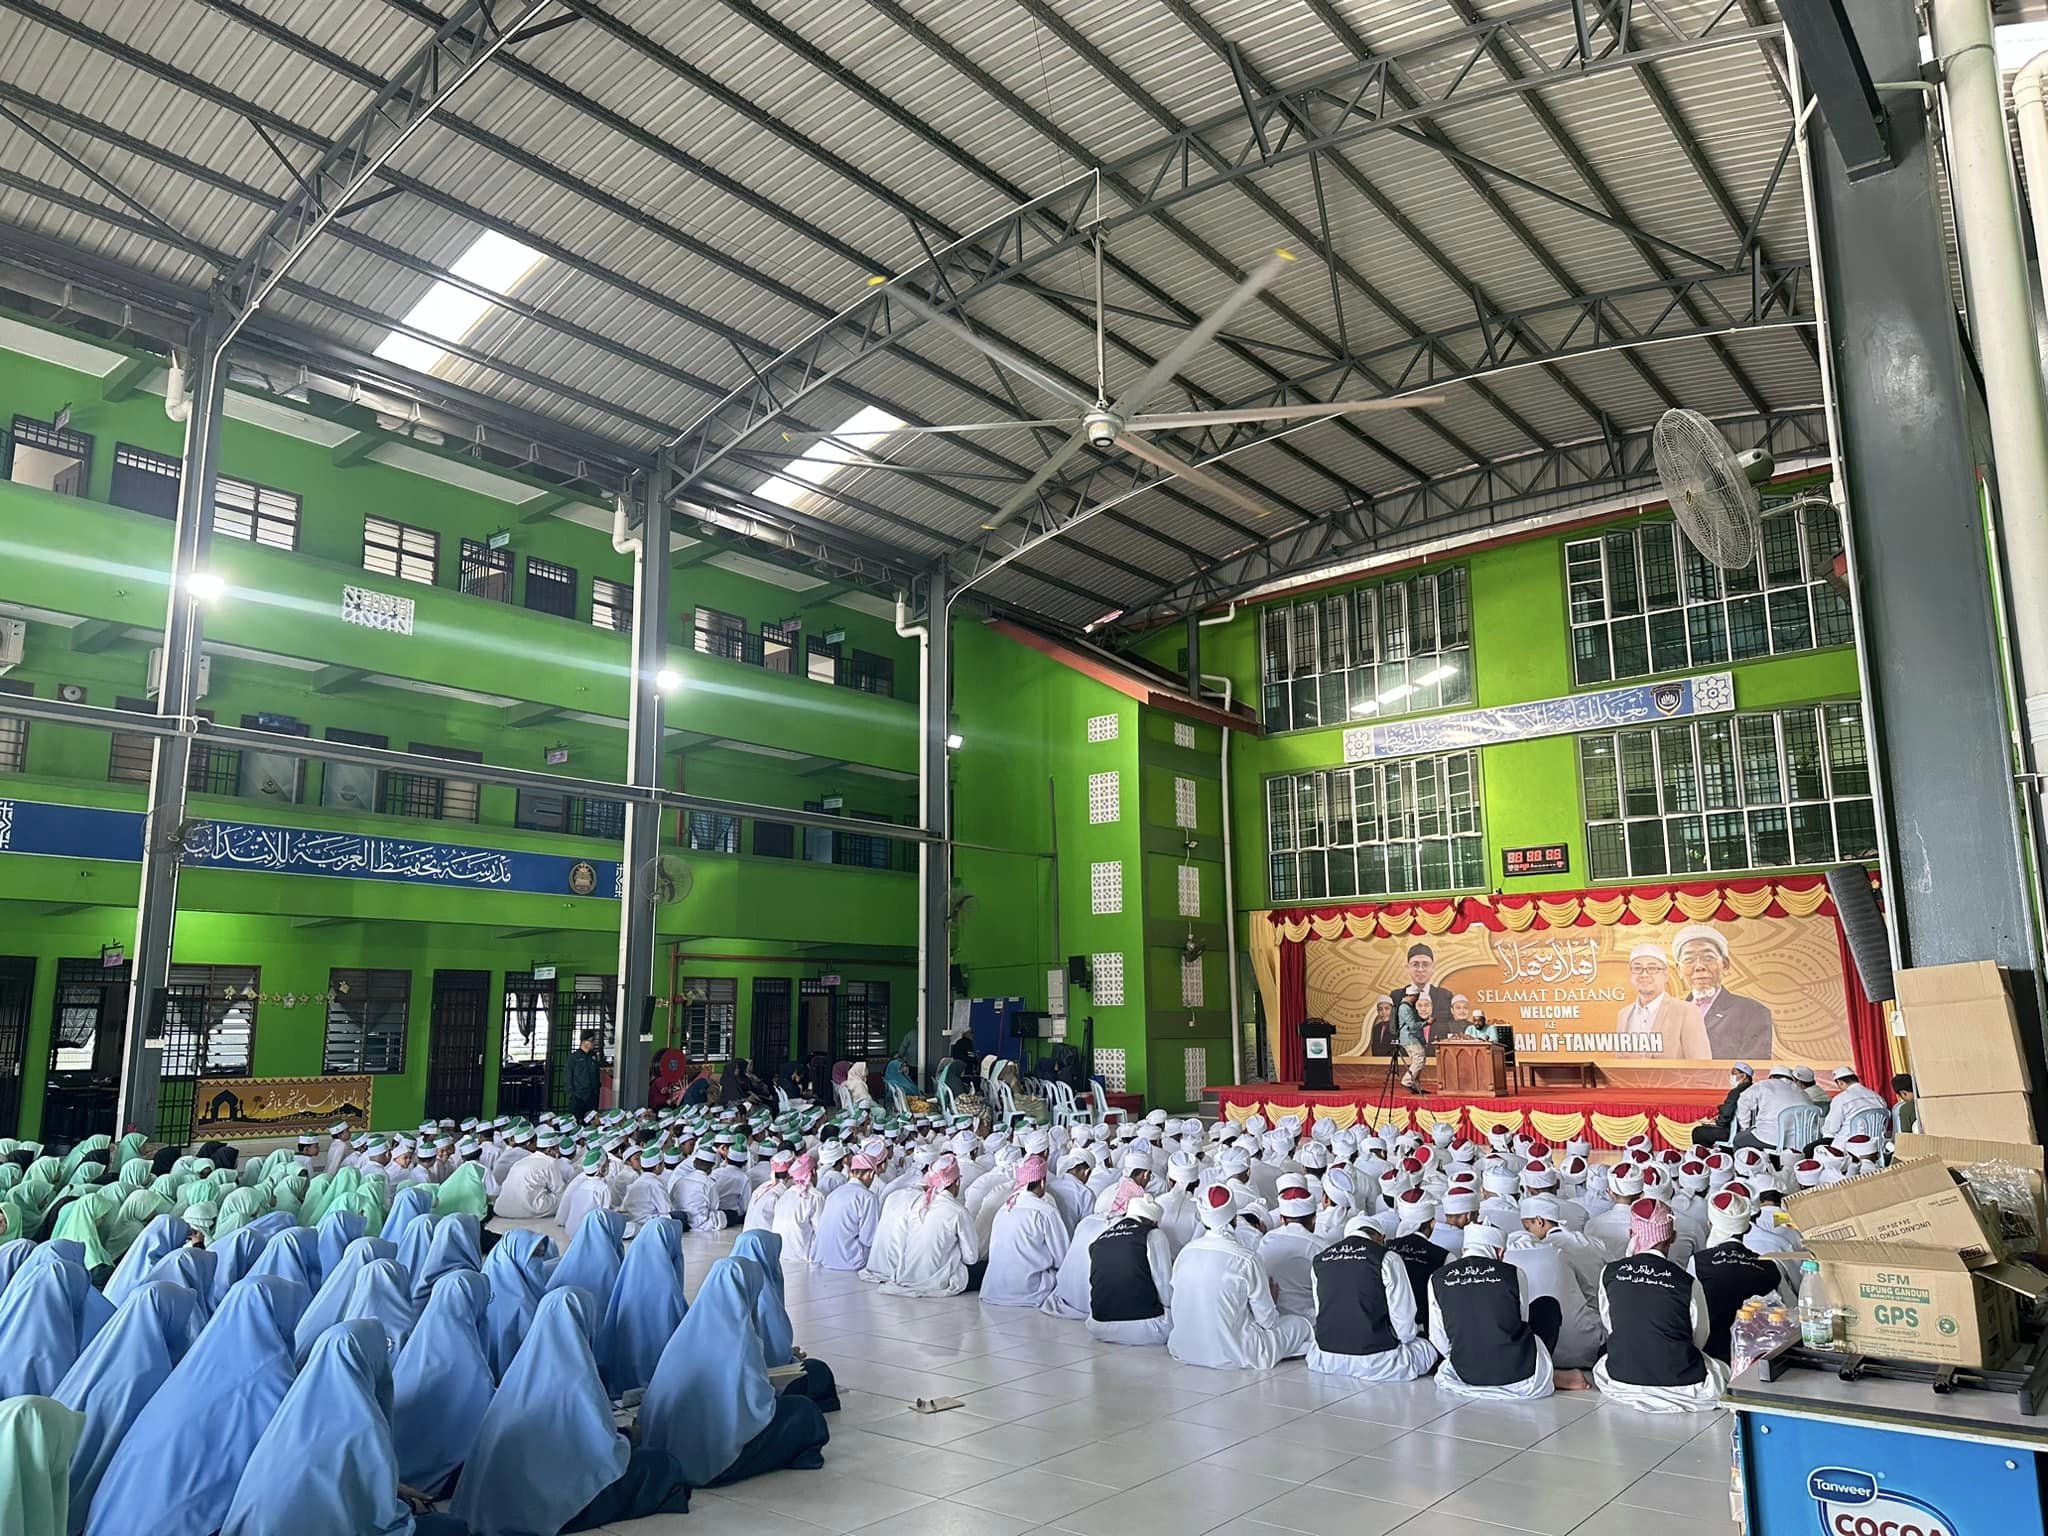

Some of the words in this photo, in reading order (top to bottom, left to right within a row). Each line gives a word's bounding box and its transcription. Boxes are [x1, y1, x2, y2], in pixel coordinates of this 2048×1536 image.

[1477, 988, 1548, 1003] SELAMAT
[1554, 986, 1626, 1002] DATANG
[1520, 1005, 1580, 1020] WELCOME
[1540, 1031, 1664, 1053] AT-TANWIRIAH
[1898, 1220, 1931, 1235] UNCANG
[1876, 1272, 1910, 1286] SFM
[1860, 1284, 1894, 1295] TEPUNG
[1894, 1288, 1929, 1298] GANDUM
[1874, 1304, 1919, 1328] GPS
[1813, 1478, 1872, 1498] Tanweer
[1834, 1513, 1944, 1536] COCO
